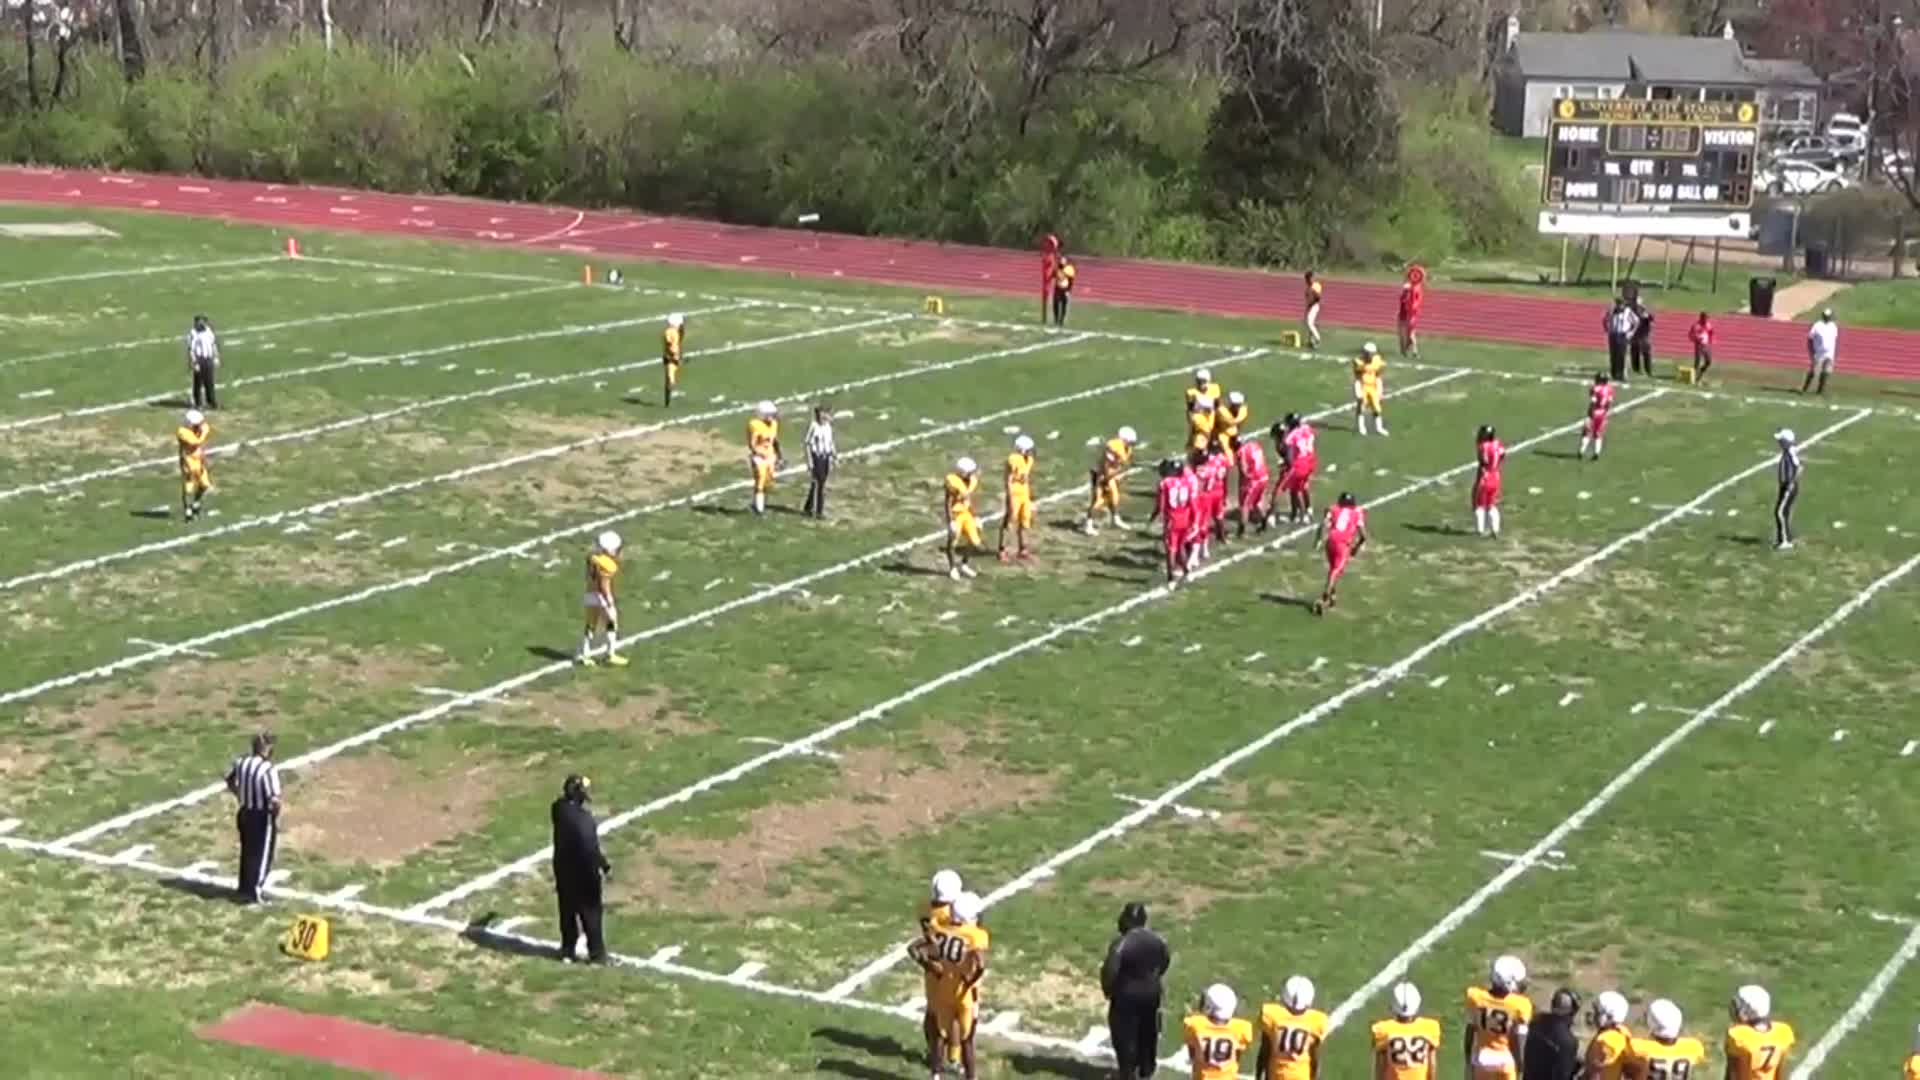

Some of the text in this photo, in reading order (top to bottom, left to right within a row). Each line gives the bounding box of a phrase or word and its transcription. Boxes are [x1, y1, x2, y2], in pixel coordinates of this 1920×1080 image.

[1558, 127, 1599, 142] HOME
[1704, 130, 1755, 145] VISITOR
[1629, 159, 1655, 175] QTR
[1565, 181, 1598, 198] DOWN
[1643, 184, 1657, 200] TO
[1658, 184, 1674, 200] GO
[1677, 184, 1702, 201] BALL
[1703, 184, 1720, 201] ON
[1480, 1007, 1510, 1034] 13
[1279, 1025, 1309, 1057] 10
[1760, 1046, 1776, 1070] 7
